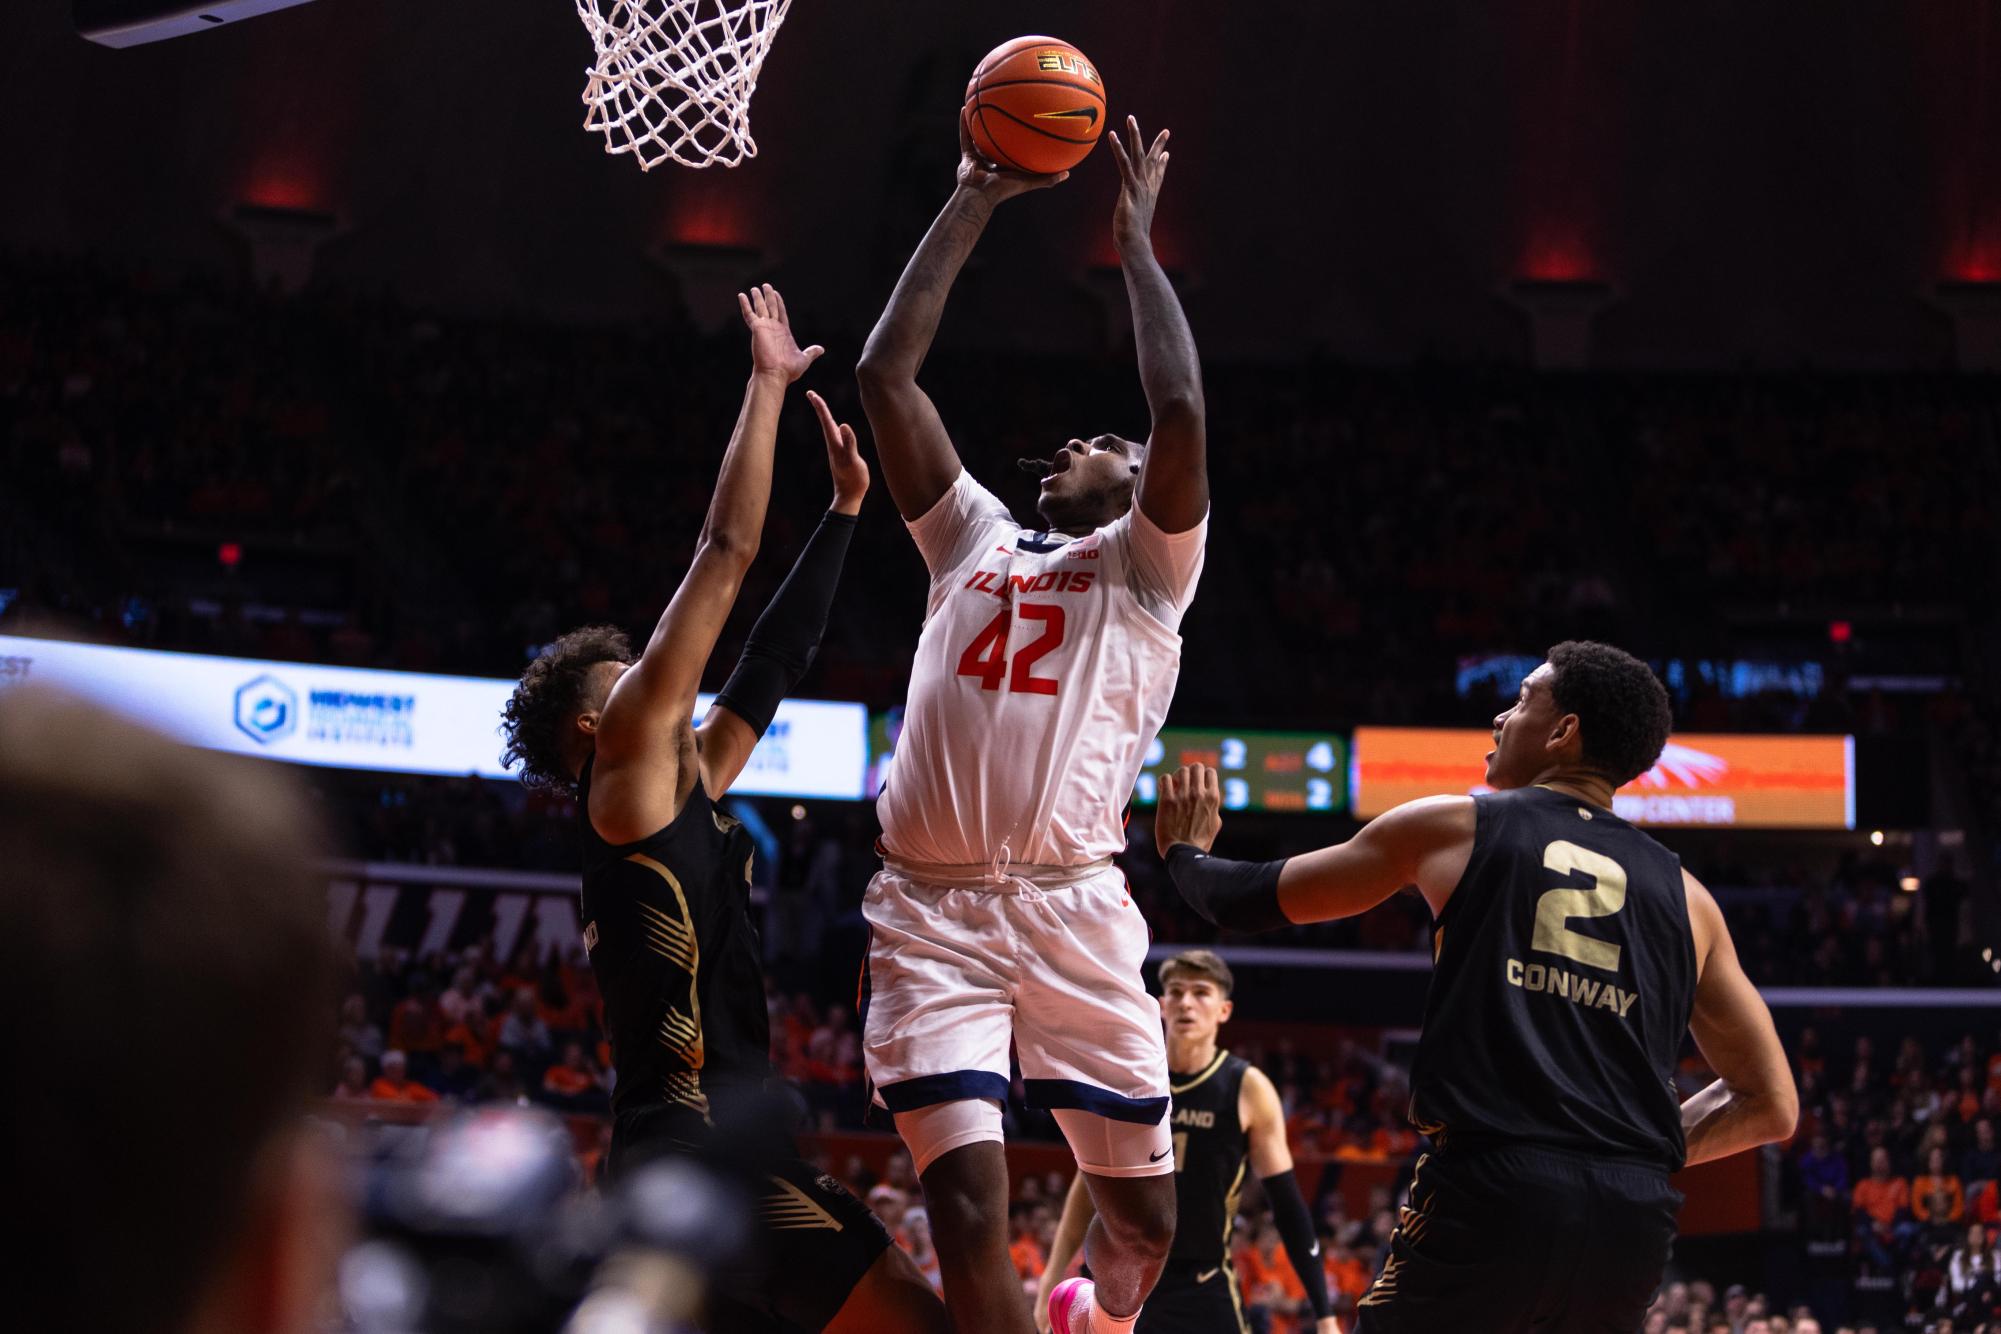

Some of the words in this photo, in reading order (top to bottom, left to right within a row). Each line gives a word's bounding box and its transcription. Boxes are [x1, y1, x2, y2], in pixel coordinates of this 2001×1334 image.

[957, 603, 1065, 696] 42
[1531, 840, 1627, 973] 2
[1507, 958, 1639, 1018] CONWAY
[1171, 1108, 1216, 1129] AND
